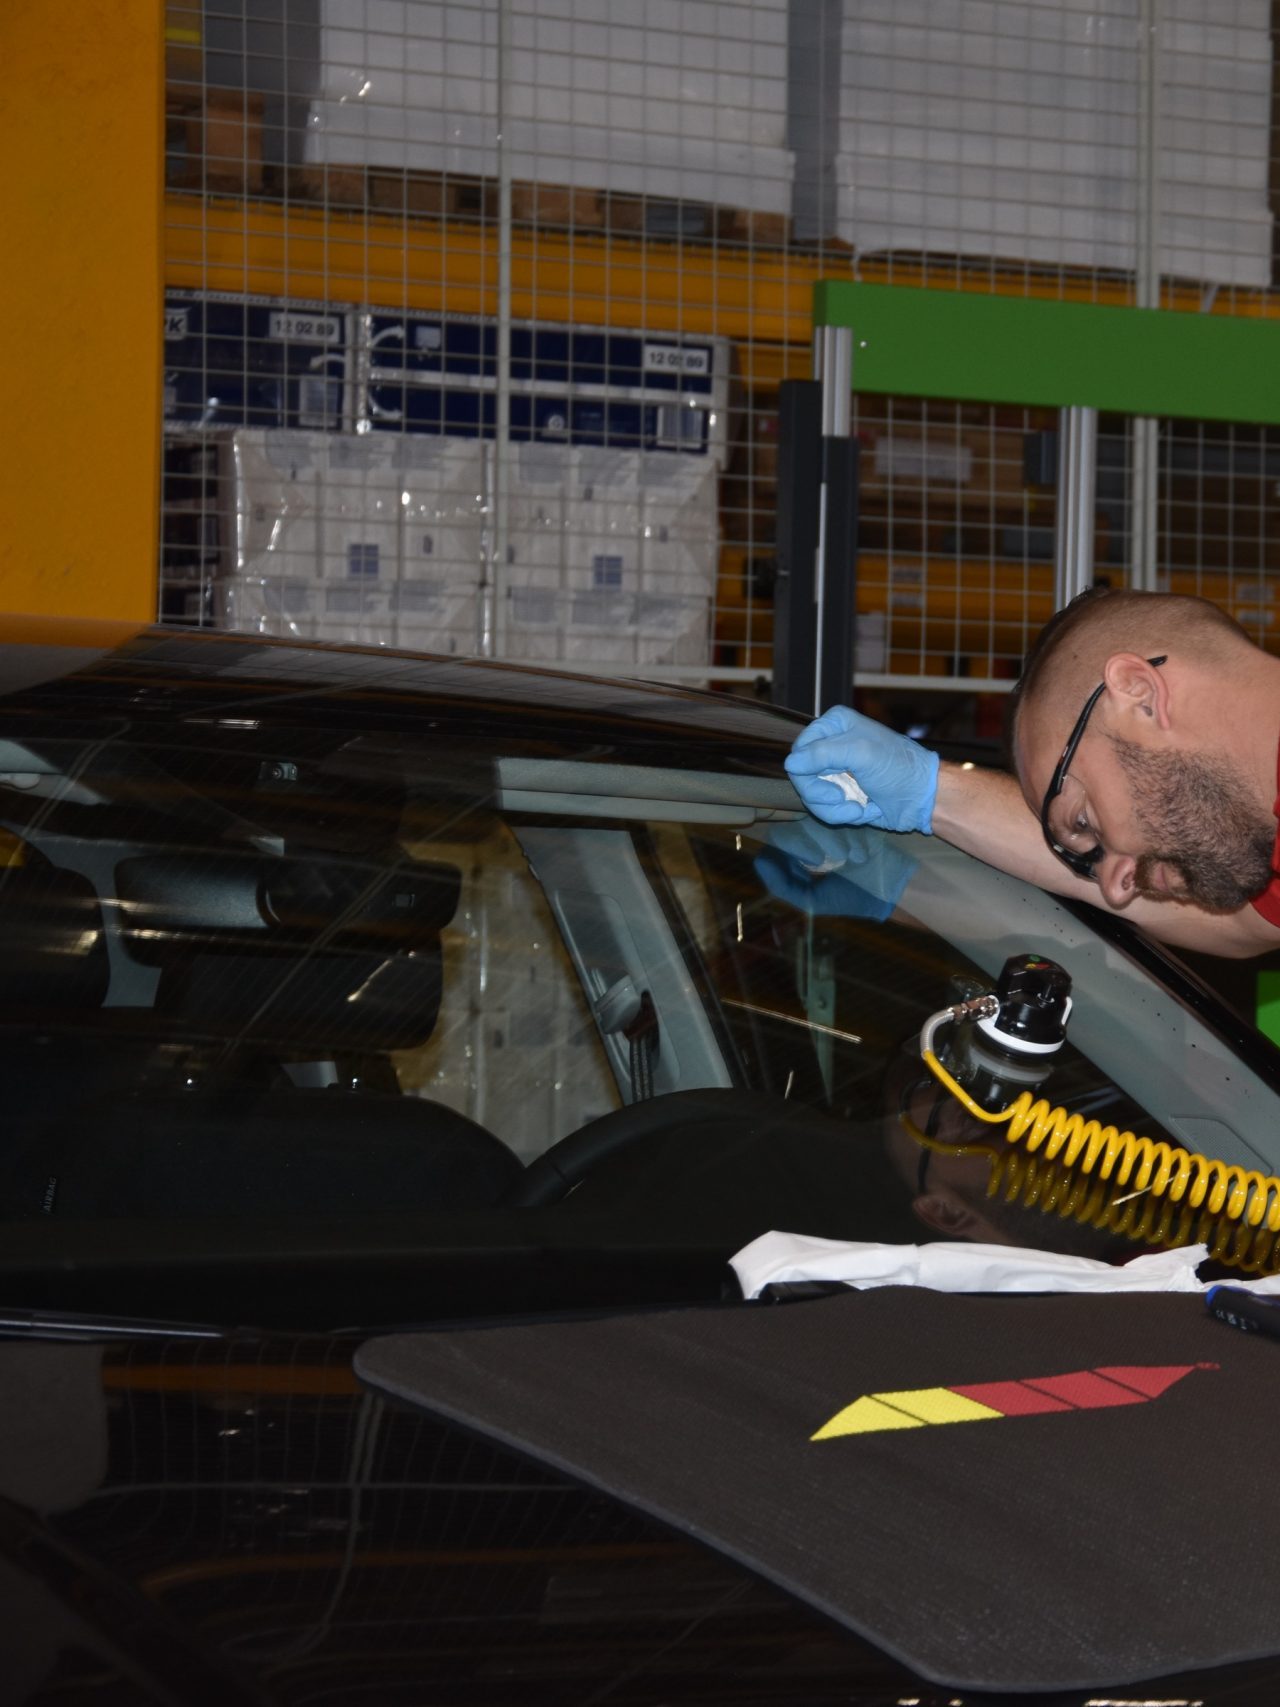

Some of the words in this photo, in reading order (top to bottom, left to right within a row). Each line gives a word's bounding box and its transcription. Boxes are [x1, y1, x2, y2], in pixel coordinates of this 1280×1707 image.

[295, 321, 313, 335] 02
[648, 351, 666, 365] 12
[686, 354, 704, 369] 89
[43, 1176, 57, 1213] AIRBAG
